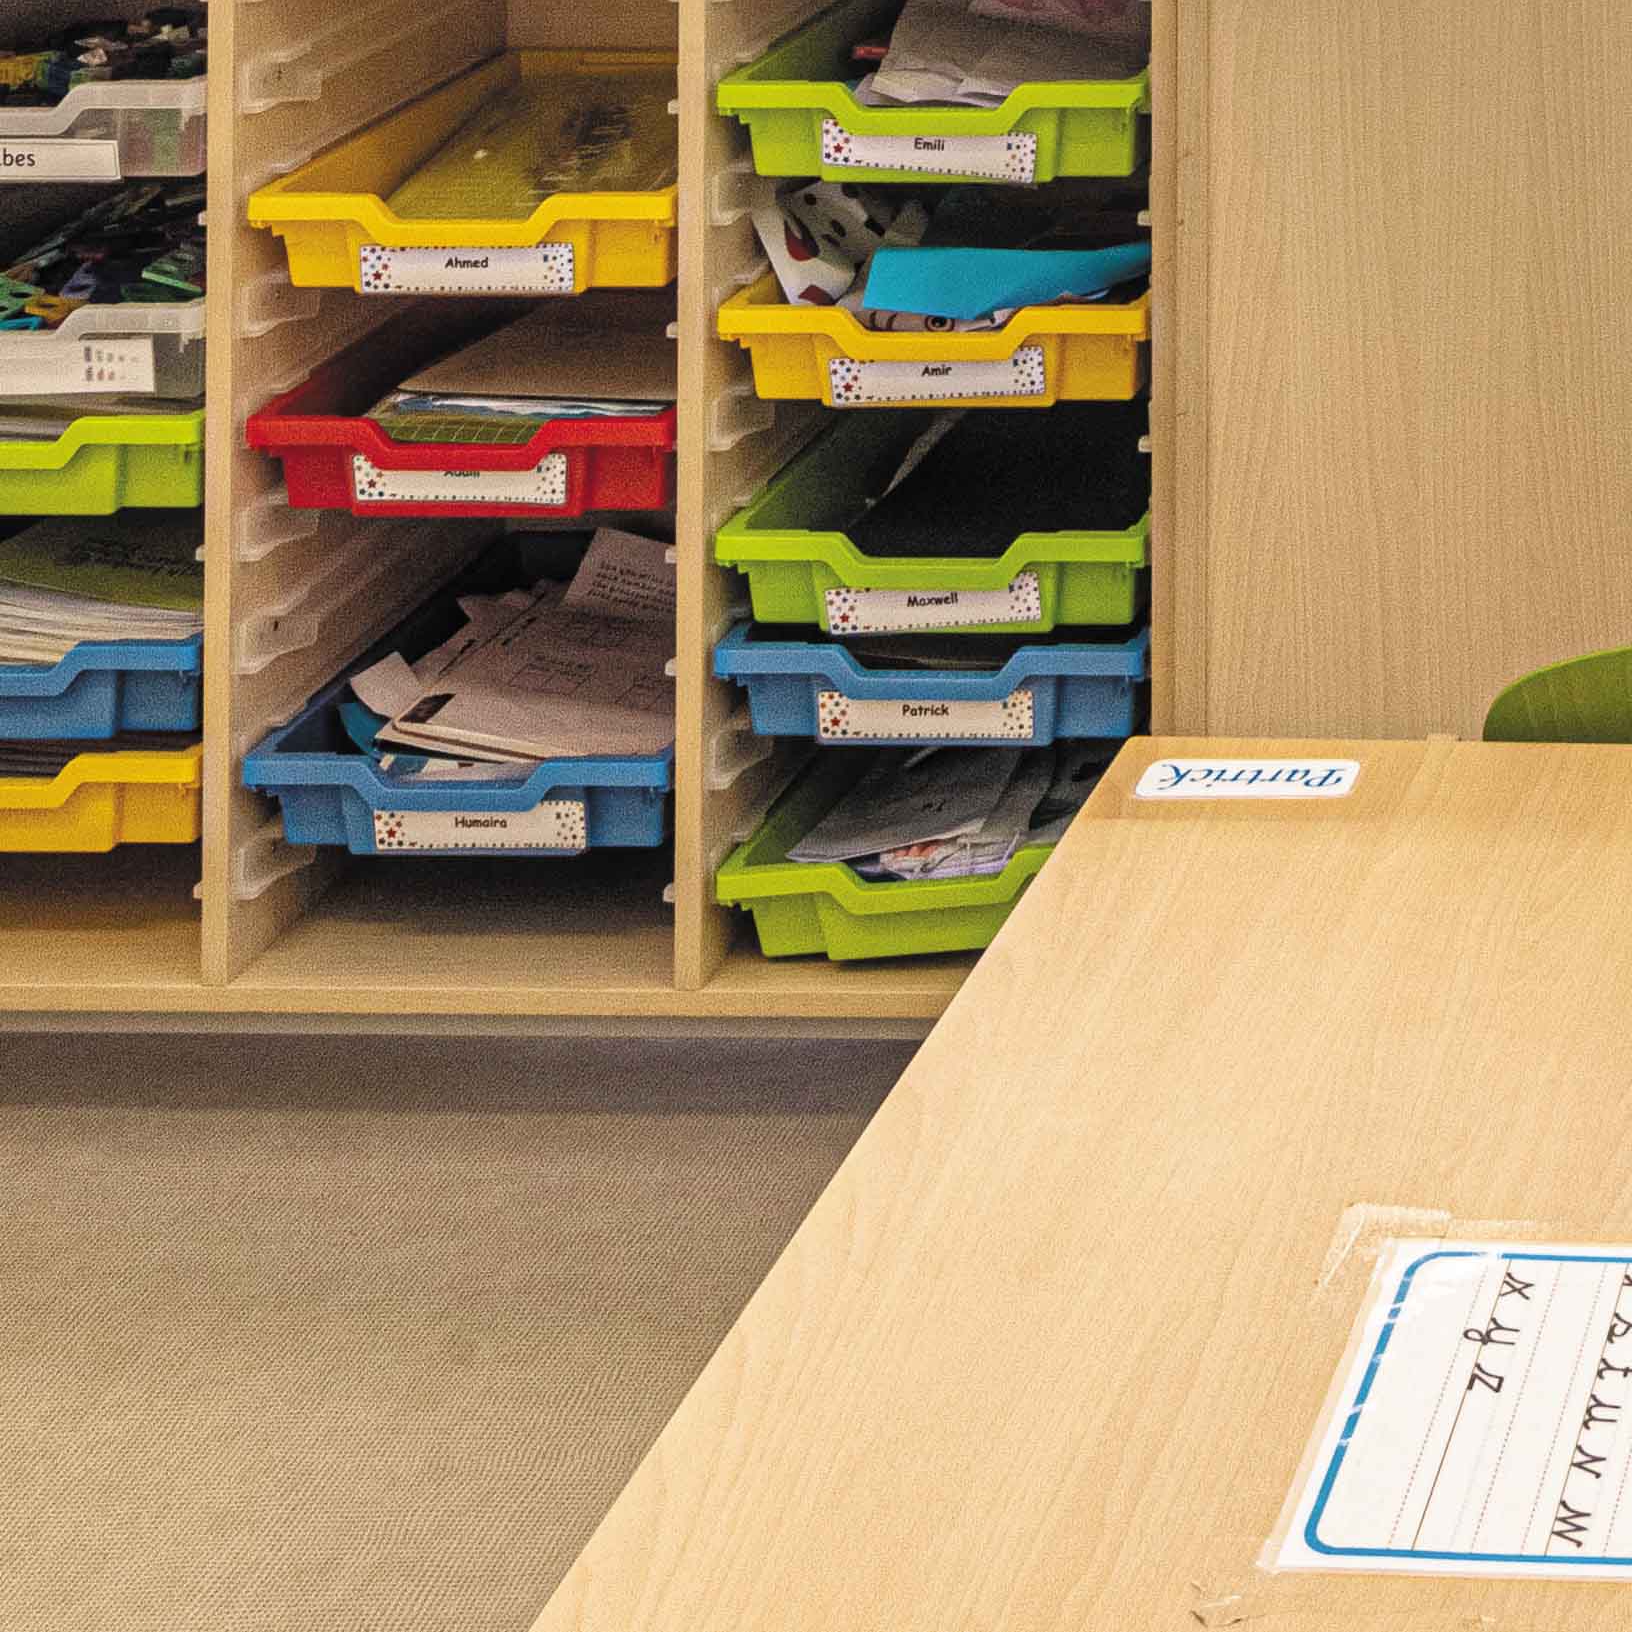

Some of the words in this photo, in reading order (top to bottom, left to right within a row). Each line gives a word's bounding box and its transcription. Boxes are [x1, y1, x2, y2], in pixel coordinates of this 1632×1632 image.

[913, 137, 946, 152] Emili
[0, 147, 37, 168] bes
[444, 255, 490, 270] Ahmed
[920, 365, 953, 378] Amir
[906, 592, 959, 608] Maxwell
[901, 703, 950, 718] Patrick
[454, 815, 509, 831] Humaira
[1500, 1272, 1535, 1301] x
[1463, 1317, 1520, 1346] y
[1467, 1363, 1504, 1393] z
[1583, 1393, 1622, 1430] u
[1571, 1444, 1607, 1479] v
[1551, 1499, 1592, 1548] w
